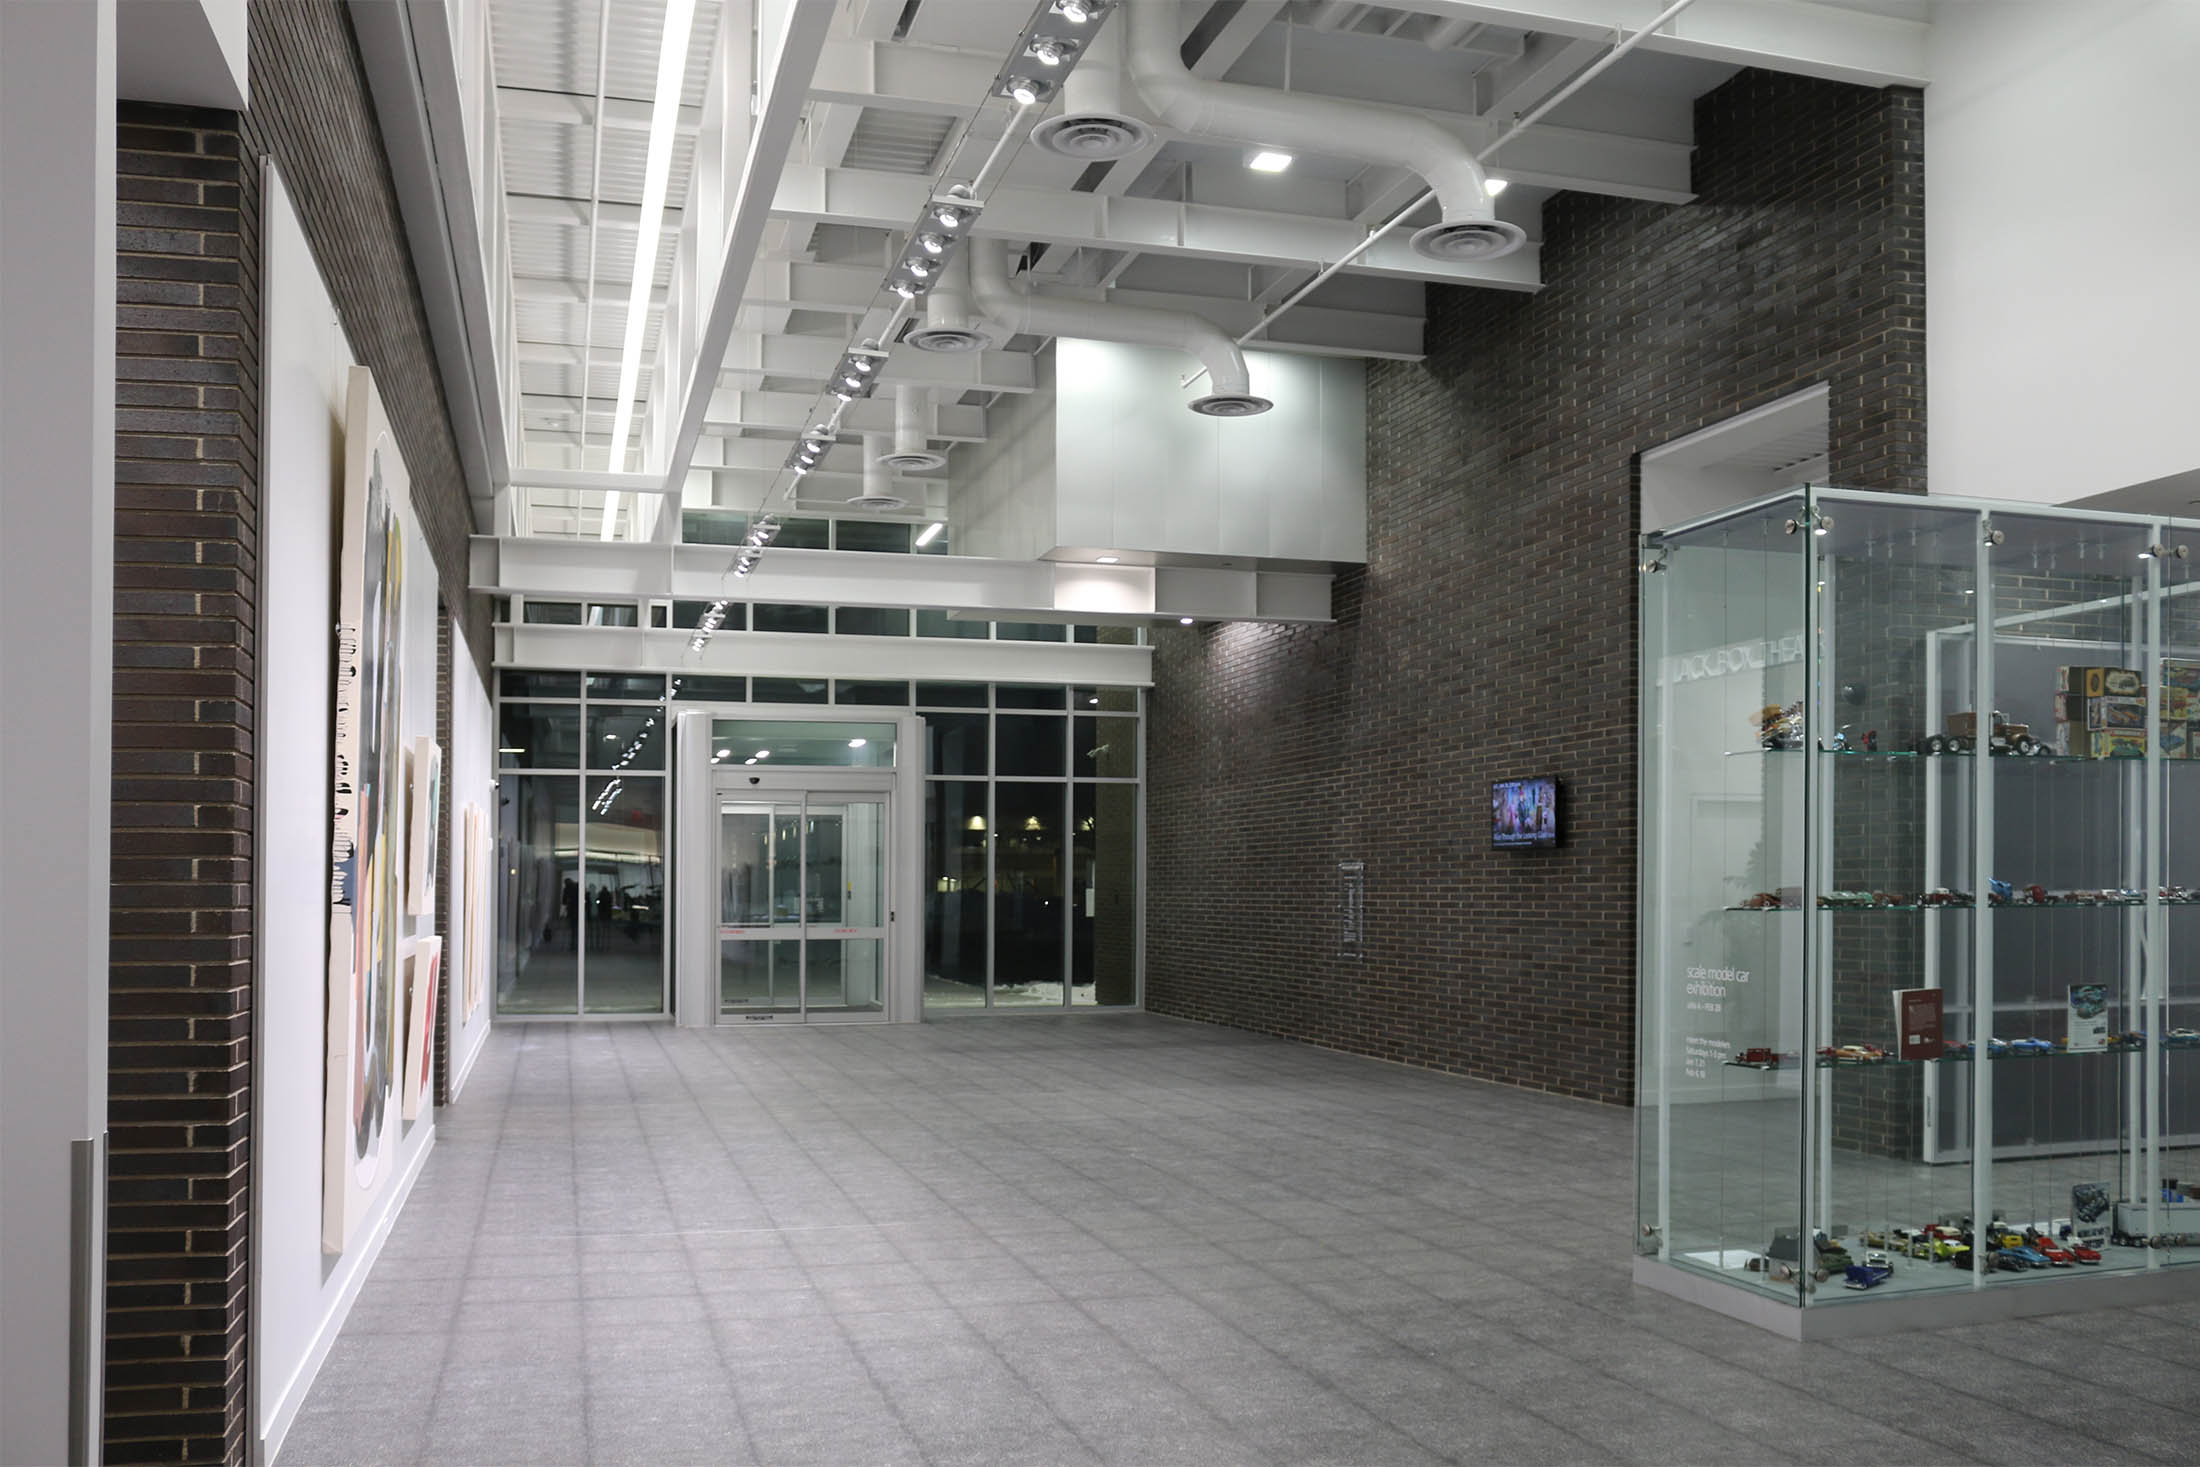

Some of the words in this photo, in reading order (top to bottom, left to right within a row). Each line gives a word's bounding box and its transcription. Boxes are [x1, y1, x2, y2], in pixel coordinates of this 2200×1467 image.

[1687, 963, 1706, 979] scale
[1707, 965, 1735, 981] model
[1735, 970, 1750, 983] car
[1687, 981, 1727, 997] exhibition
